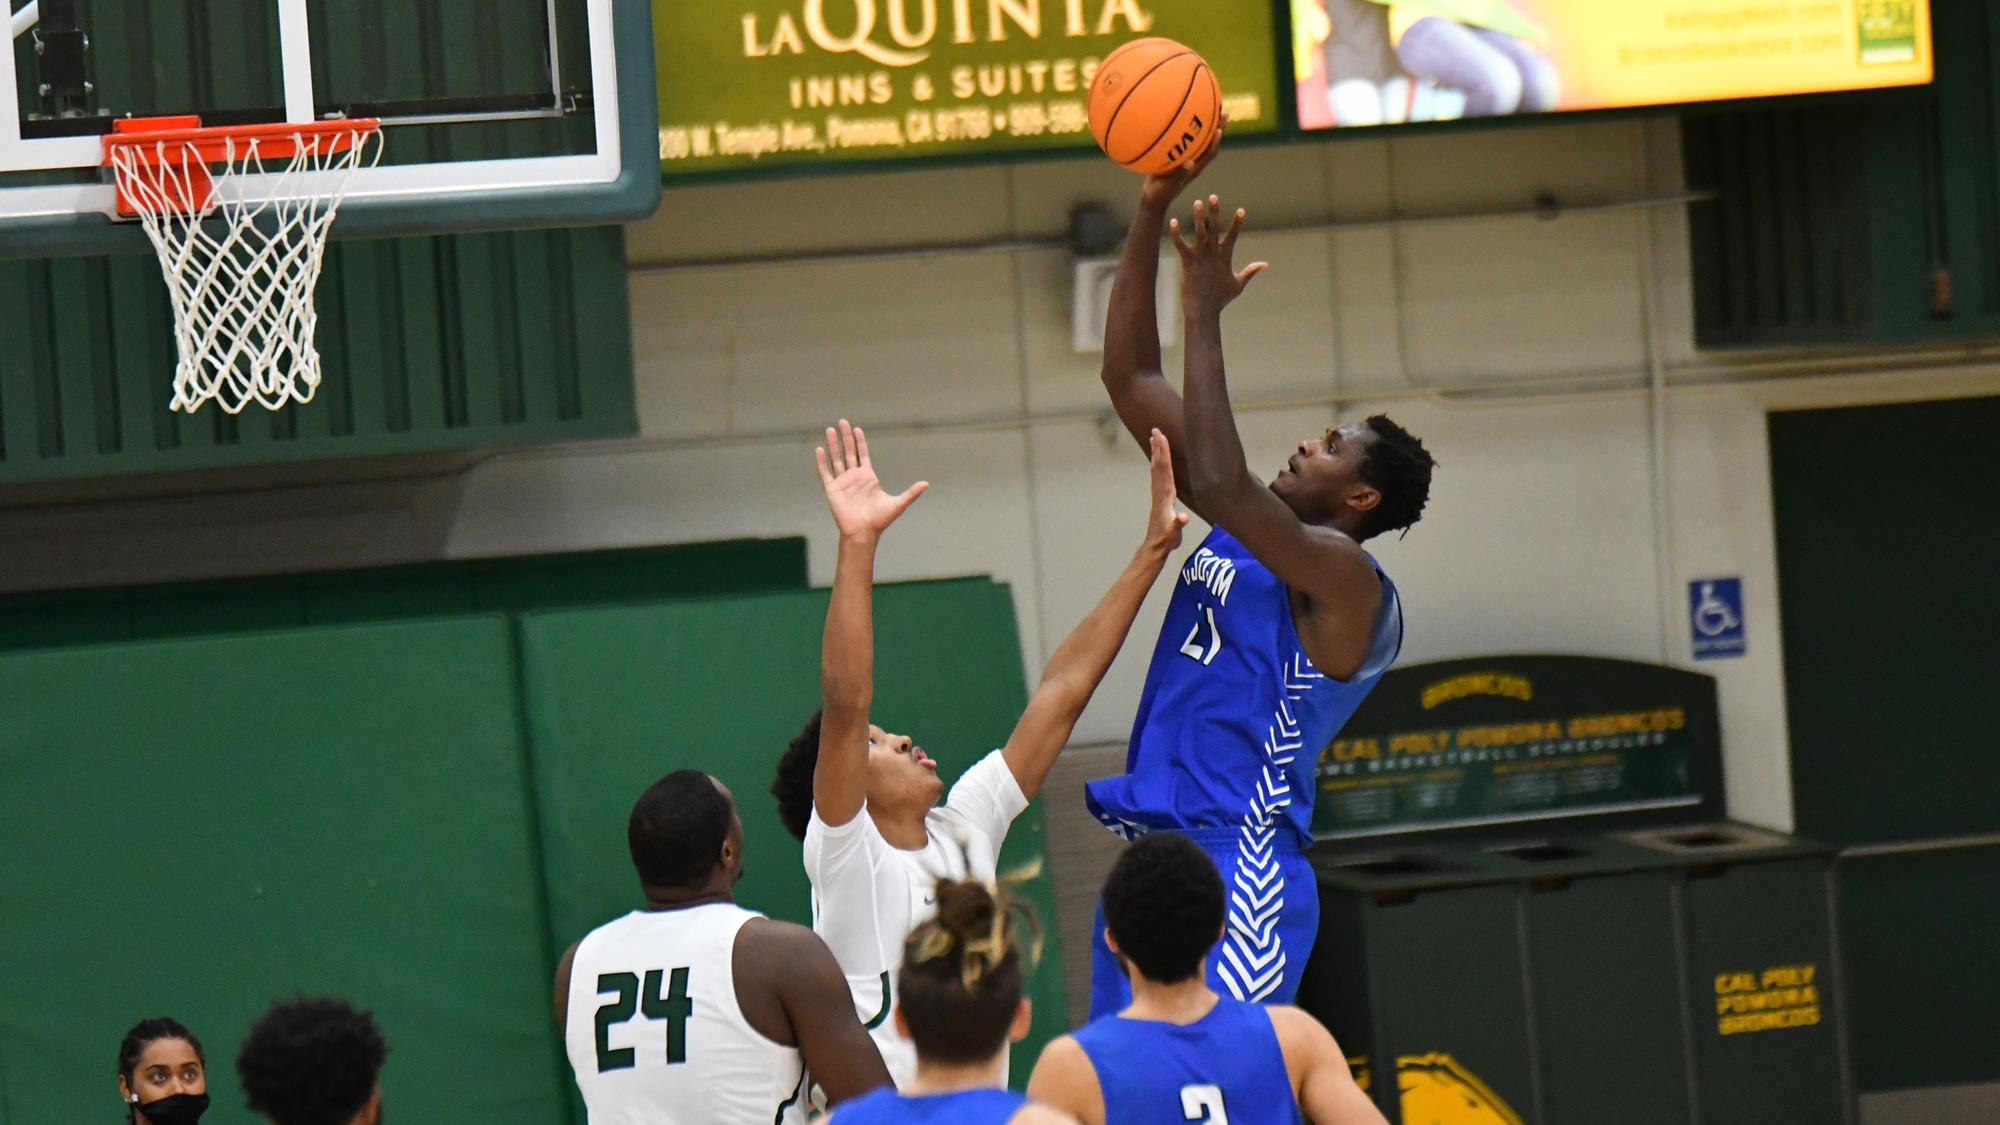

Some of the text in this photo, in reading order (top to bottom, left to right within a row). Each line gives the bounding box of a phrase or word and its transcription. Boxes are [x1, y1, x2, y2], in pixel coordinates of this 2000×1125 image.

[789, 56, 1099, 109] INNS & SUITES
[905, 109, 933, 143] CA
[1714, 963, 1816, 995] CAL POLY
[1715, 984, 1819, 1015] POMONA
[594, 966, 693, 1074] 24
[1719, 1006, 1822, 1037] BRONCOS
